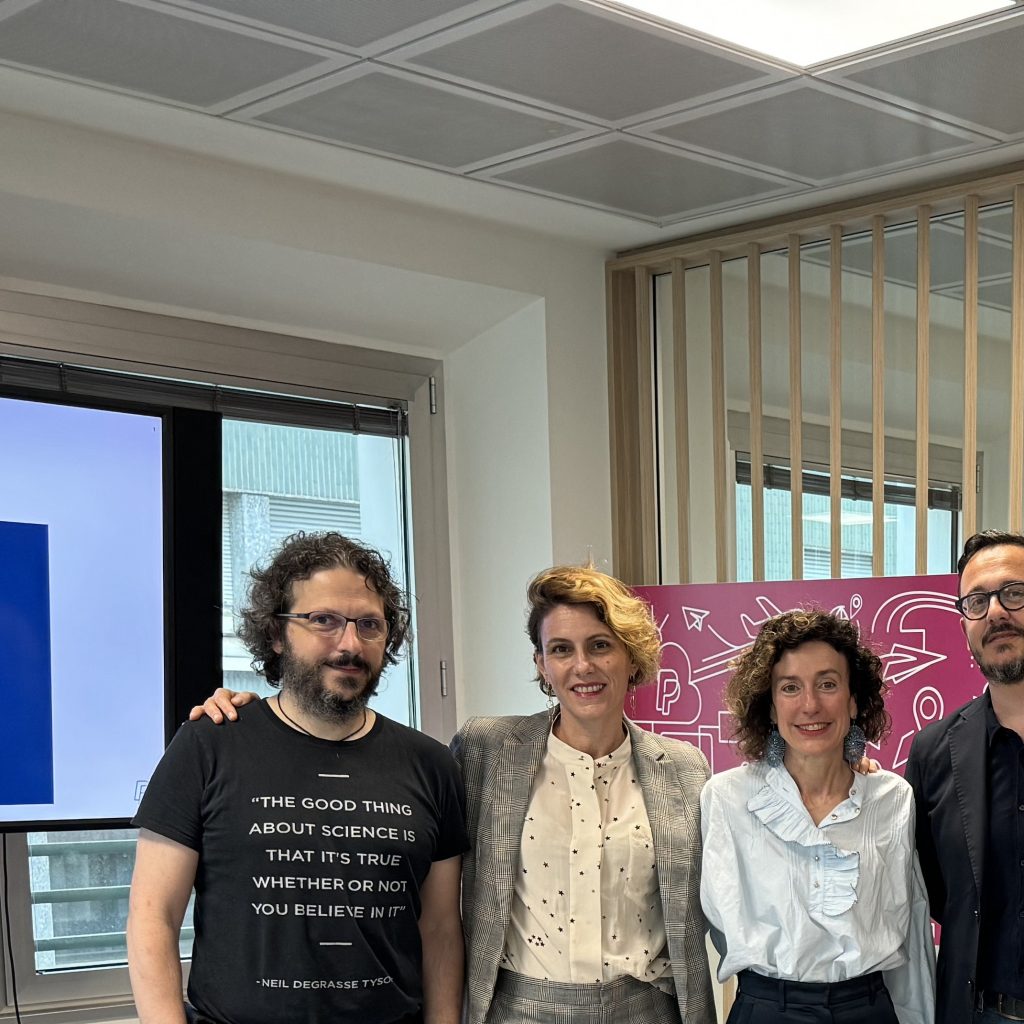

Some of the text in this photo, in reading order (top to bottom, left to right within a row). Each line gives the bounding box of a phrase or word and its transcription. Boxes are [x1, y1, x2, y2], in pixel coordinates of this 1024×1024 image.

[252, 796, 413, 816] “THE GOOD THING
[249, 822, 416, 842] ABOUT SCIENCE IS
[266, 849, 402, 867] THAT IT'S TRUE
[252, 876, 408, 893] WHETHER OR NOT
[252, 903, 288, 916] YOU
[294, 904, 364, 918] BELIEVE
[370, 906, 385, 918] IN
[293, 980, 359, 989] DEGRASSE
